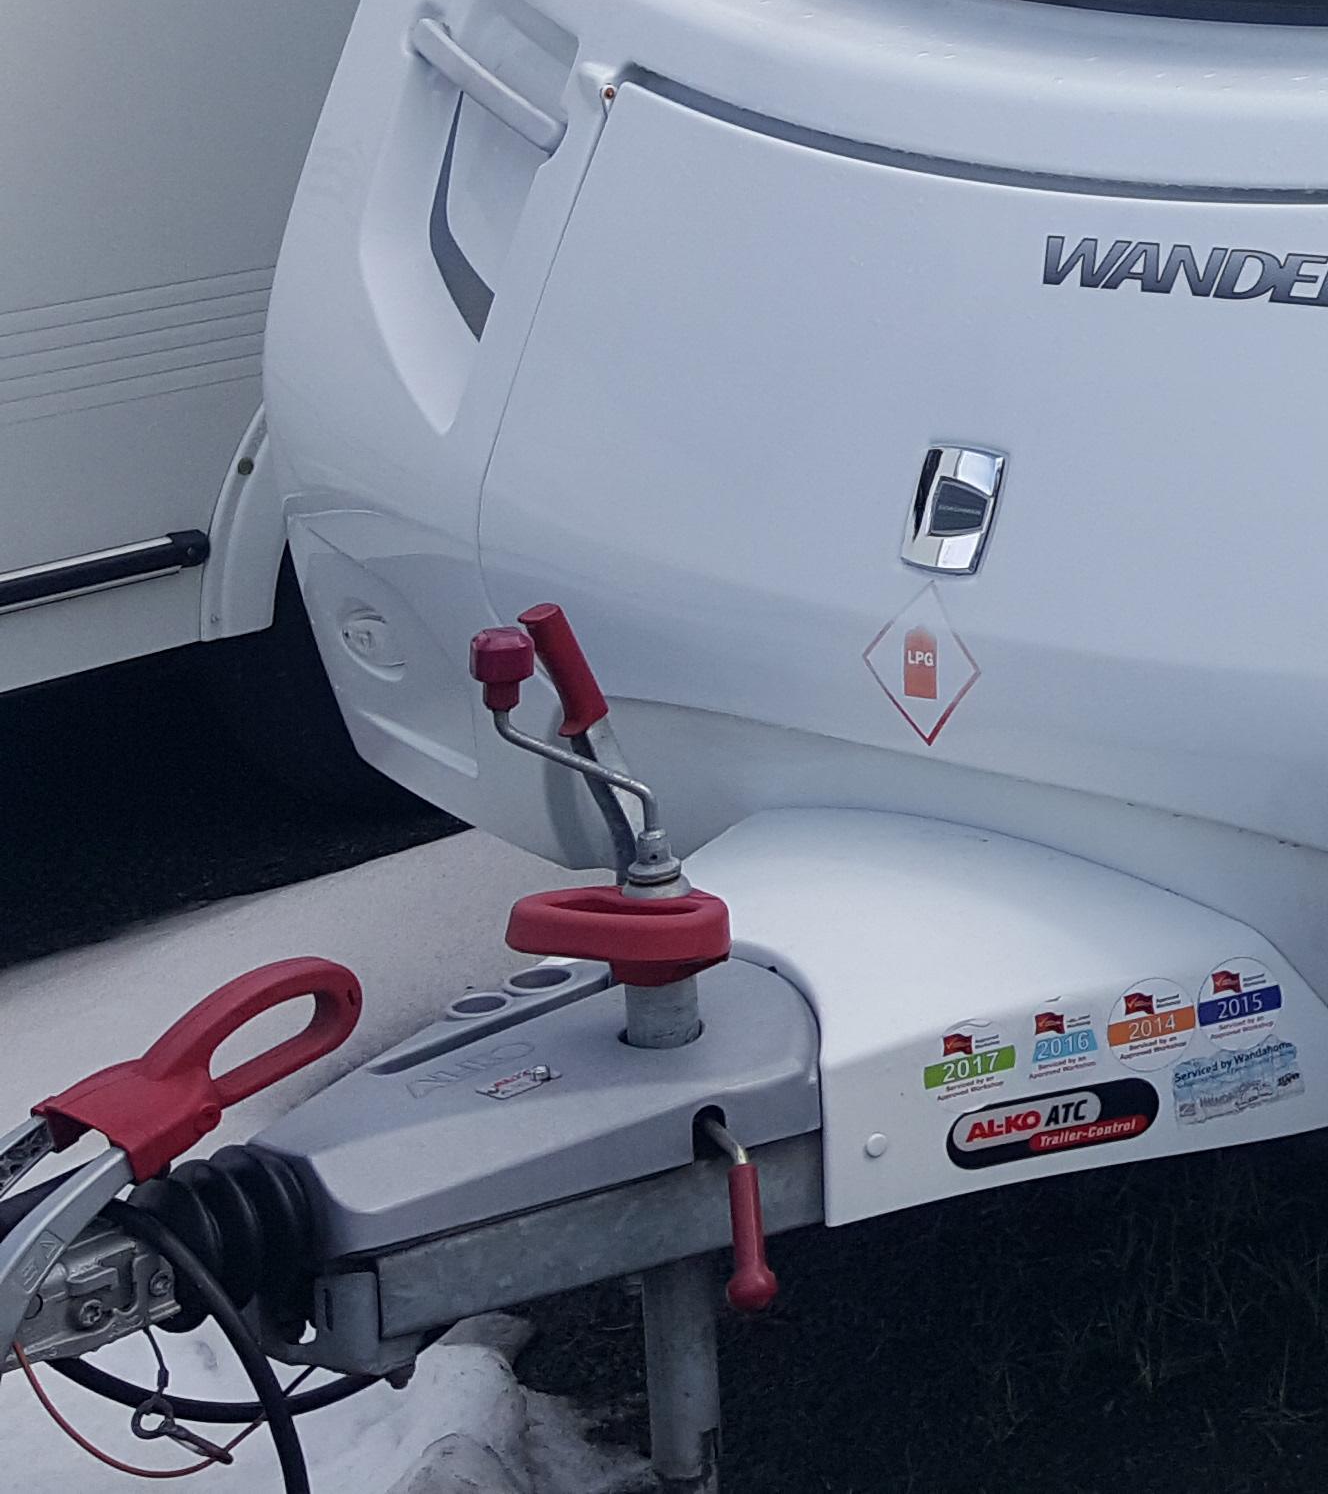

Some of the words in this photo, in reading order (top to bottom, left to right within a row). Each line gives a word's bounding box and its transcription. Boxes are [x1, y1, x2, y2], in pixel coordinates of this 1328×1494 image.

[907, 650, 935, 667] LPG
[1217, 992, 1263, 1020] 2015
[1128, 1014, 1176, 1040] 2014
[1037, 1032, 1089, 1060] 2016
[942, 1051, 999, 1083] 2017
[1174, 1061, 1218, 1083] Serviced
[1220, 1059, 1232, 1069] by
[965, 1110, 1042, 1143] AL-KO
[1044, 1099, 1088, 1127] ATC
[1039, 1118, 1137, 1148] Trailer-Control
